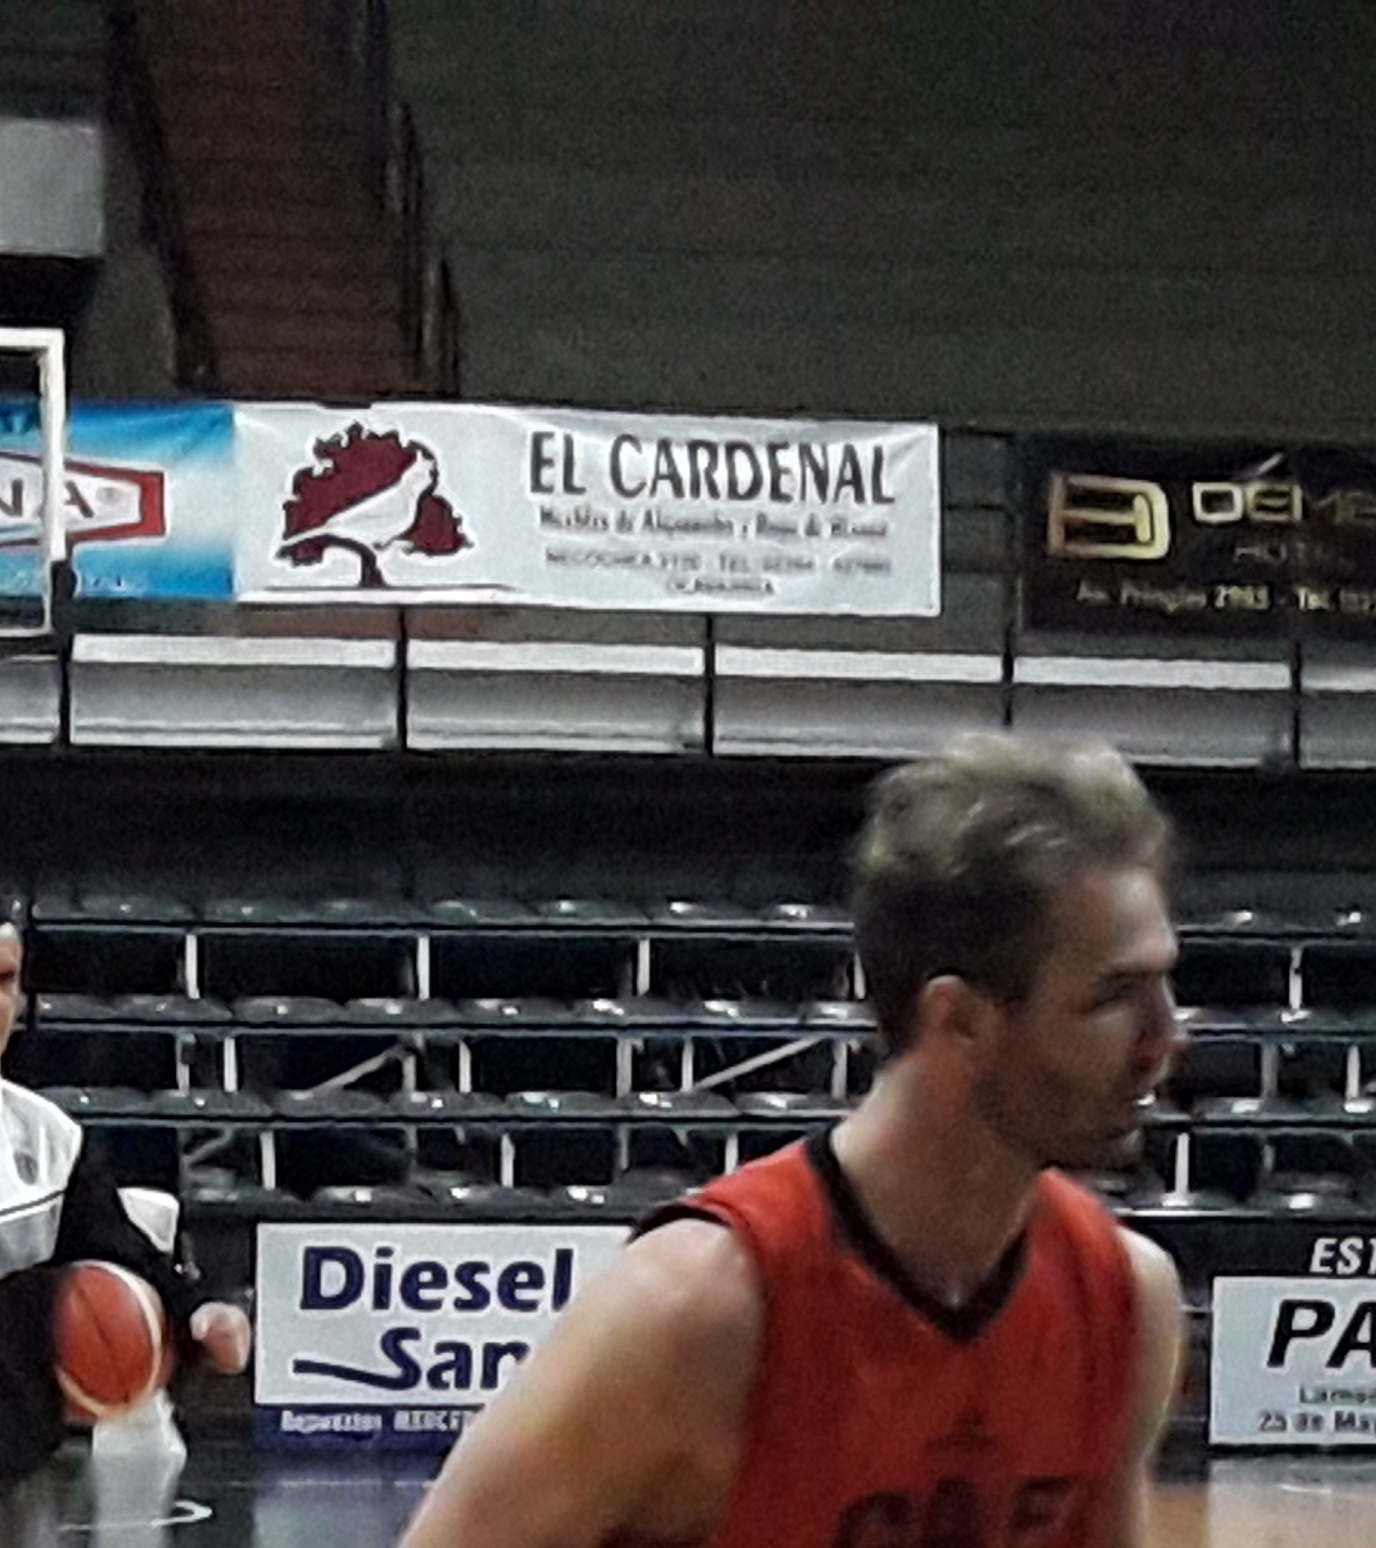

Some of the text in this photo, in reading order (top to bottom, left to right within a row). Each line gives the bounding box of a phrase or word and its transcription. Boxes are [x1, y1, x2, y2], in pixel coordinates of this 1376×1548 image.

[530, 430, 896, 504] EL CARDENAL
[299, 1246, 574, 1312] Diesel
